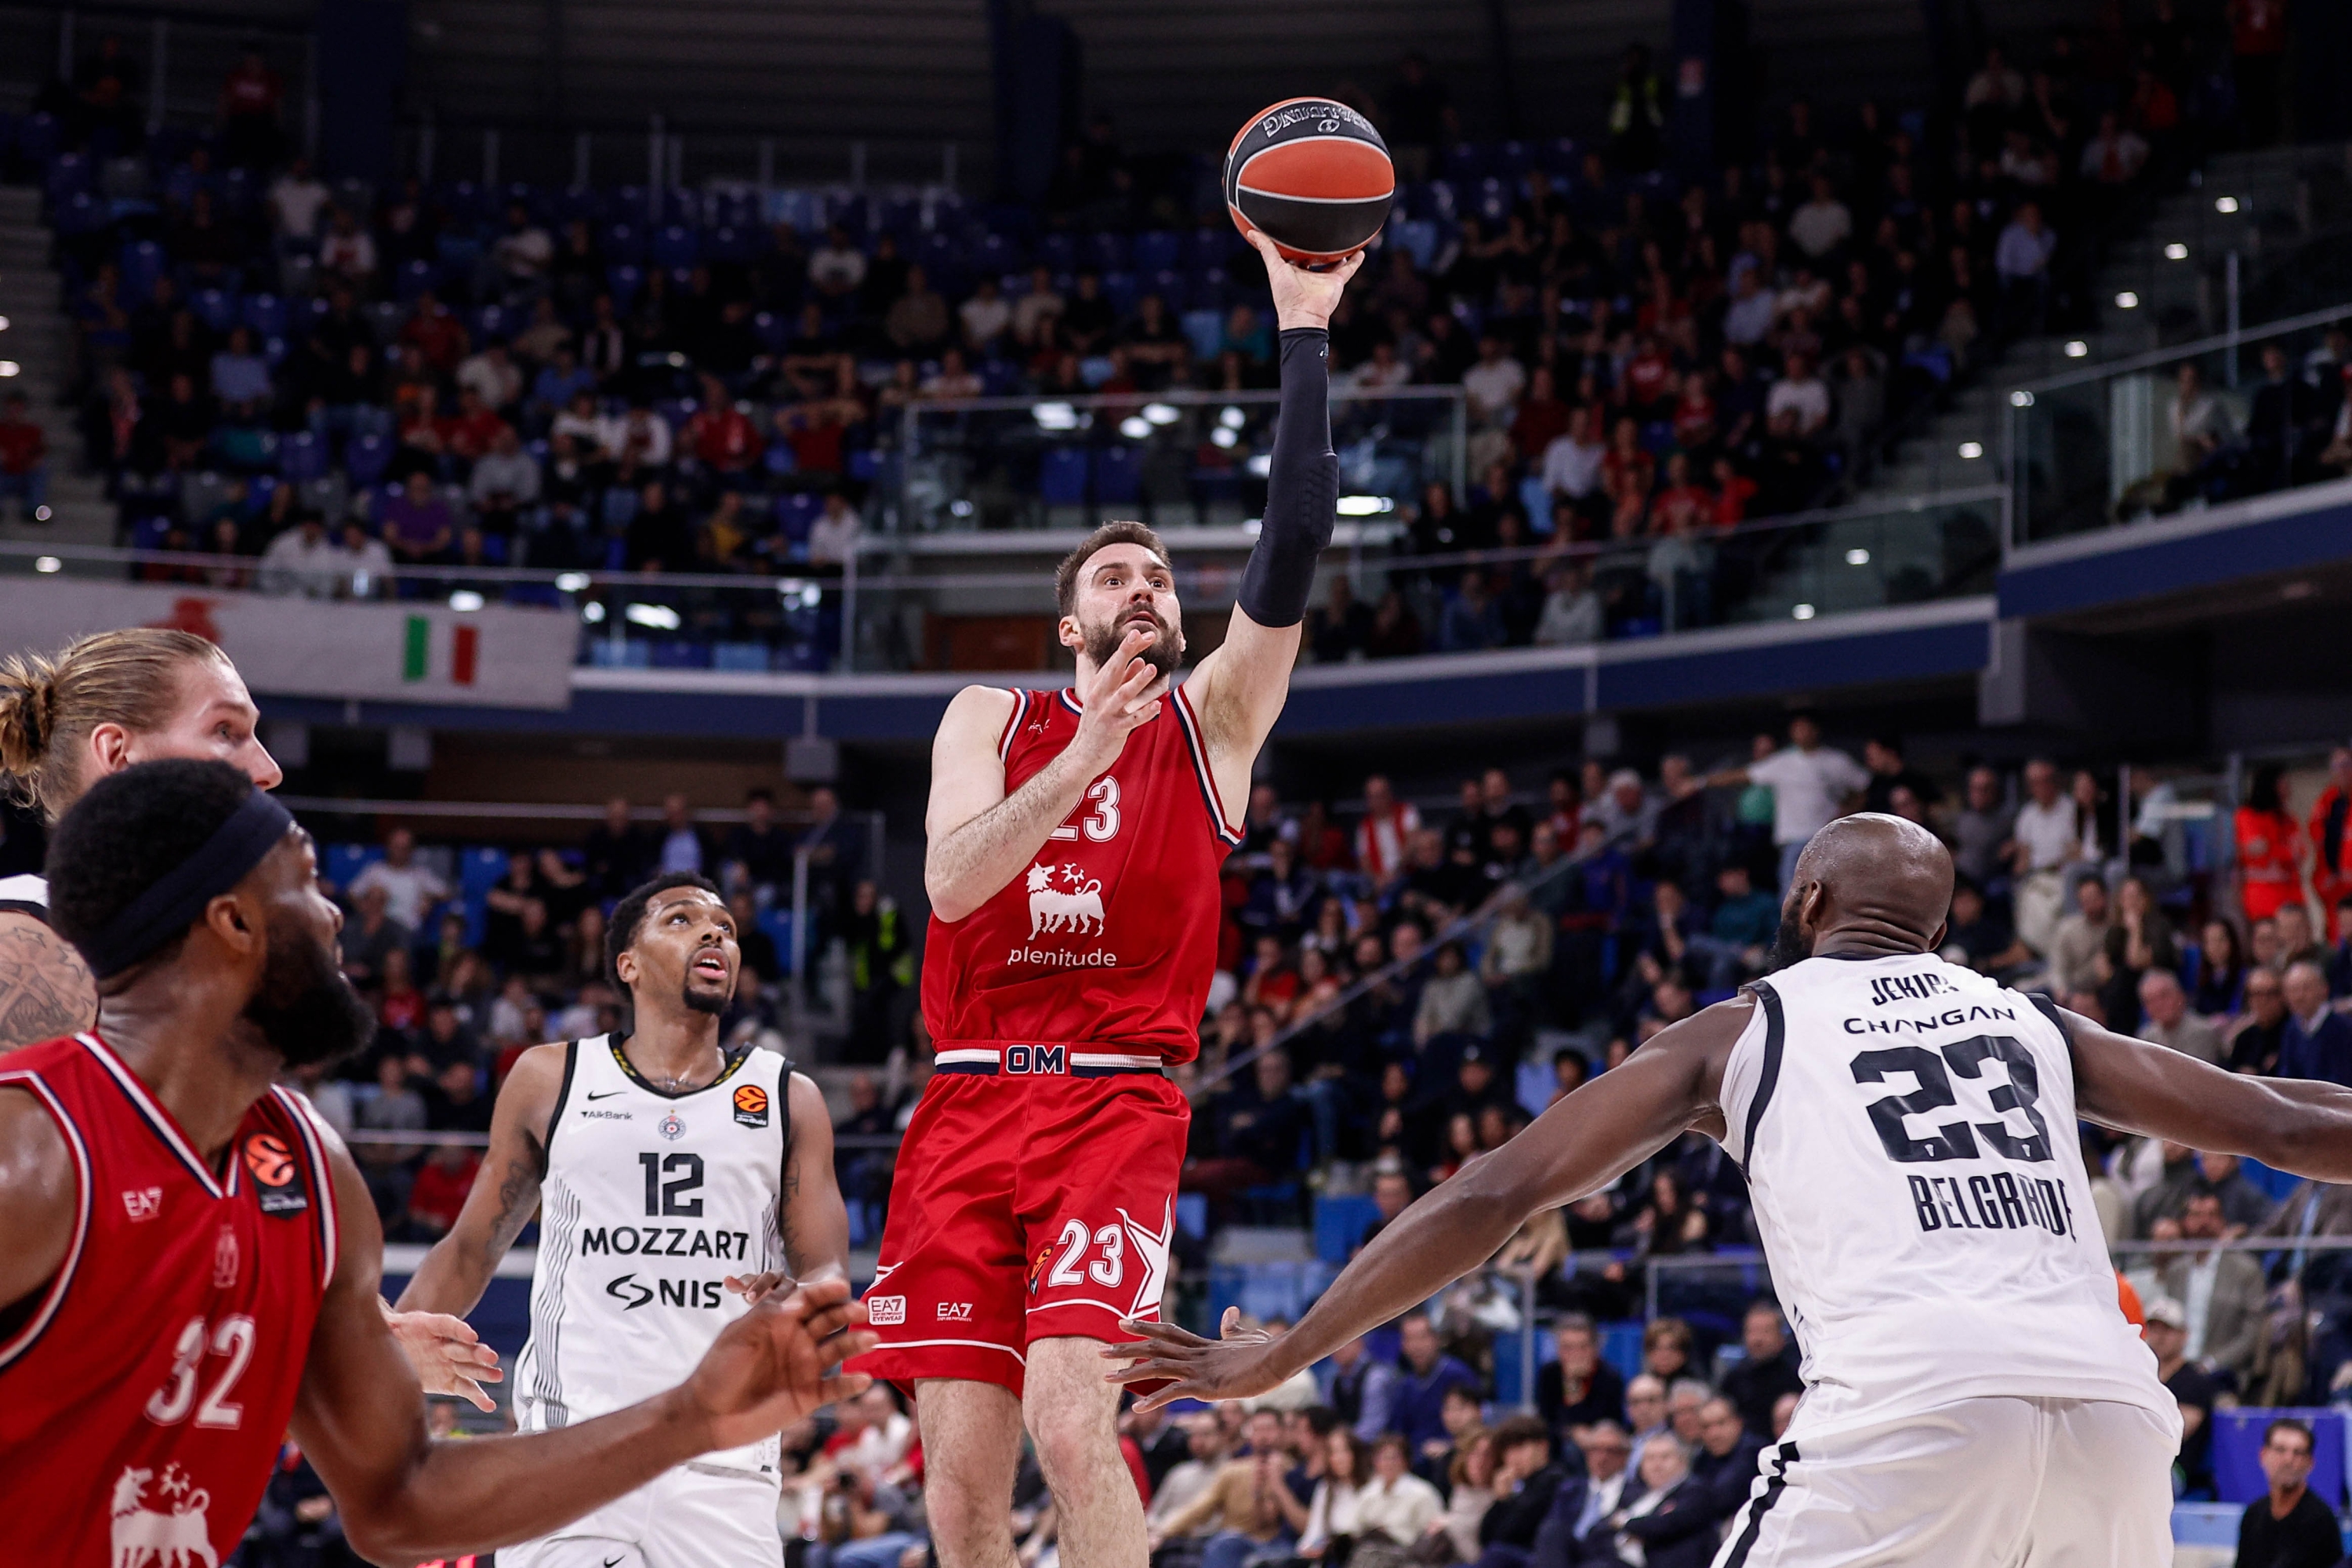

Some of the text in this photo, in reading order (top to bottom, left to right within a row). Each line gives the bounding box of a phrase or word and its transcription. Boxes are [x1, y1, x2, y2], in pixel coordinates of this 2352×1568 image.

[1007, 946, 1117, 967] plenitude
[1843, 1006, 2016, 1034] CHANGAN
[1006, 1044, 1065, 1074] OM
[1849, 1034, 2056, 1163] 23
[639, 1152, 704, 1218] 12
[122, 1186, 162, 1216] EA7
[582, 1226, 750, 1261] MOZZART
[1047, 1218, 1123, 1288] 23
[659, 1278, 723, 1309] NIS
[871, 1298, 902, 1312] EA7
[937, 1302, 973, 1317] EA7
[143, 1312, 257, 1430] 32
